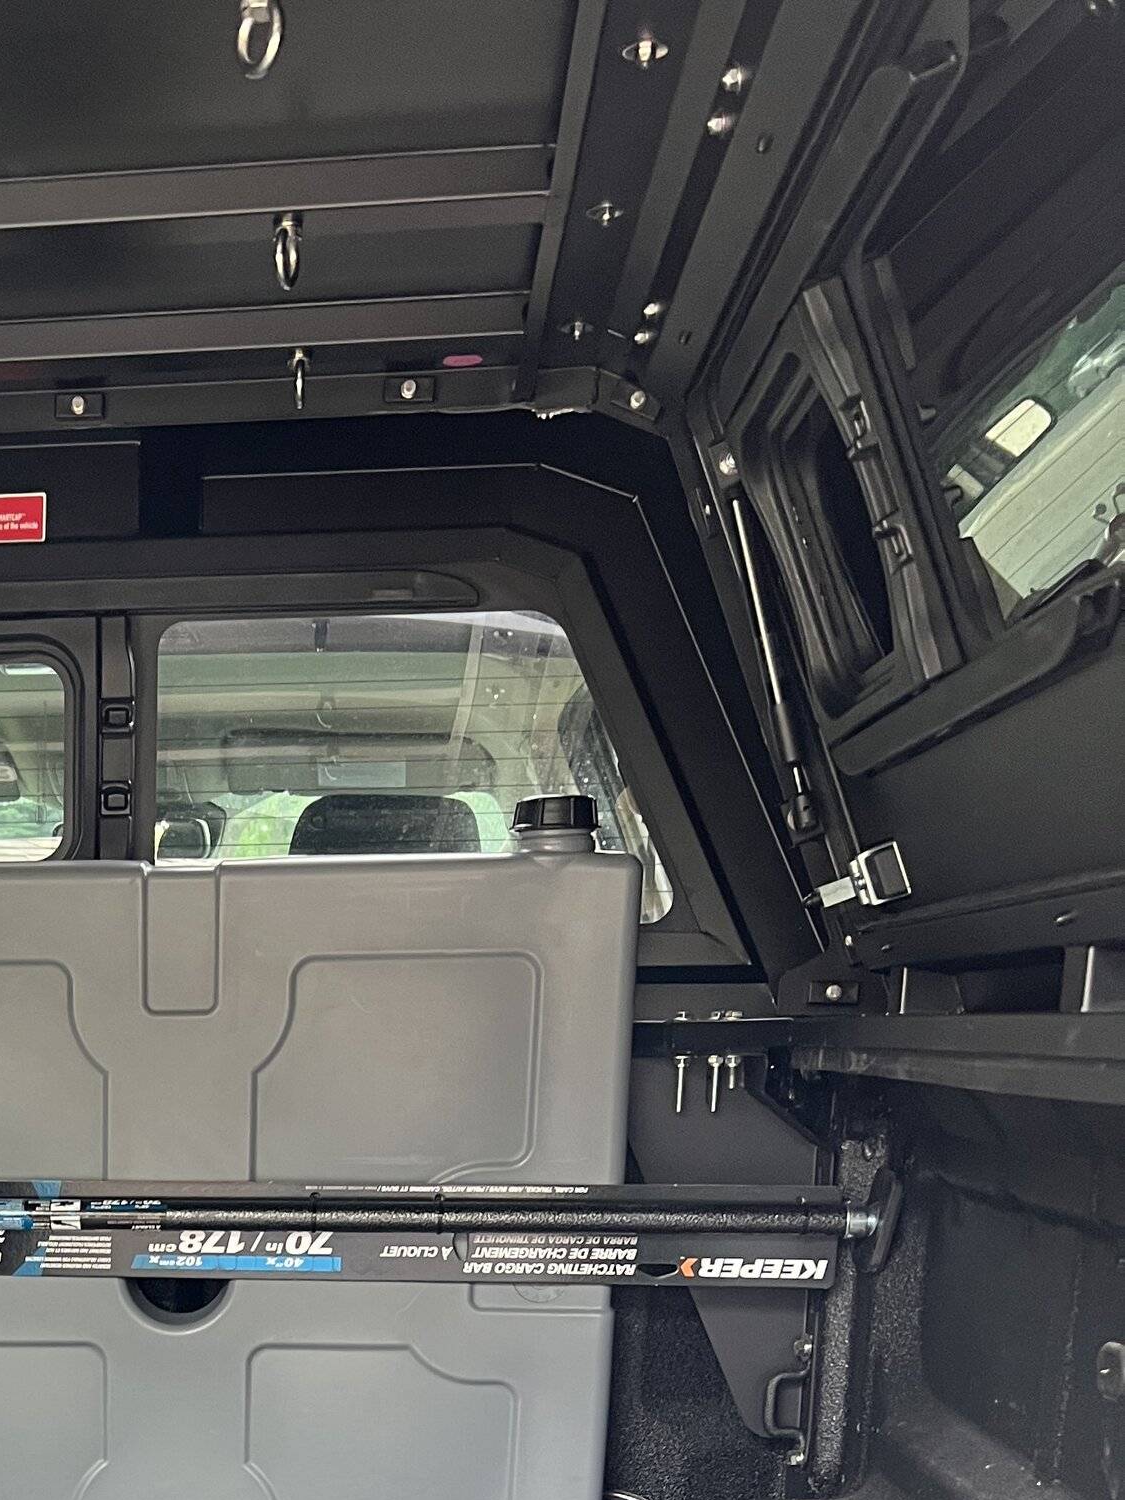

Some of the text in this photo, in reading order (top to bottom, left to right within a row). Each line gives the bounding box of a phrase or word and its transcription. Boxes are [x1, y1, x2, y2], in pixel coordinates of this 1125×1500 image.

[473, 1234, 638, 1245] BARRA DE CARGA DE TRINQUETE
[379, 1246, 638, 1260] BARRE DE CHARGEMENT À CLIQUET
[463, 1261, 637, 1276] RATCHETING CARGO BAR
[697, 1258, 829, 1280] KEEPER
